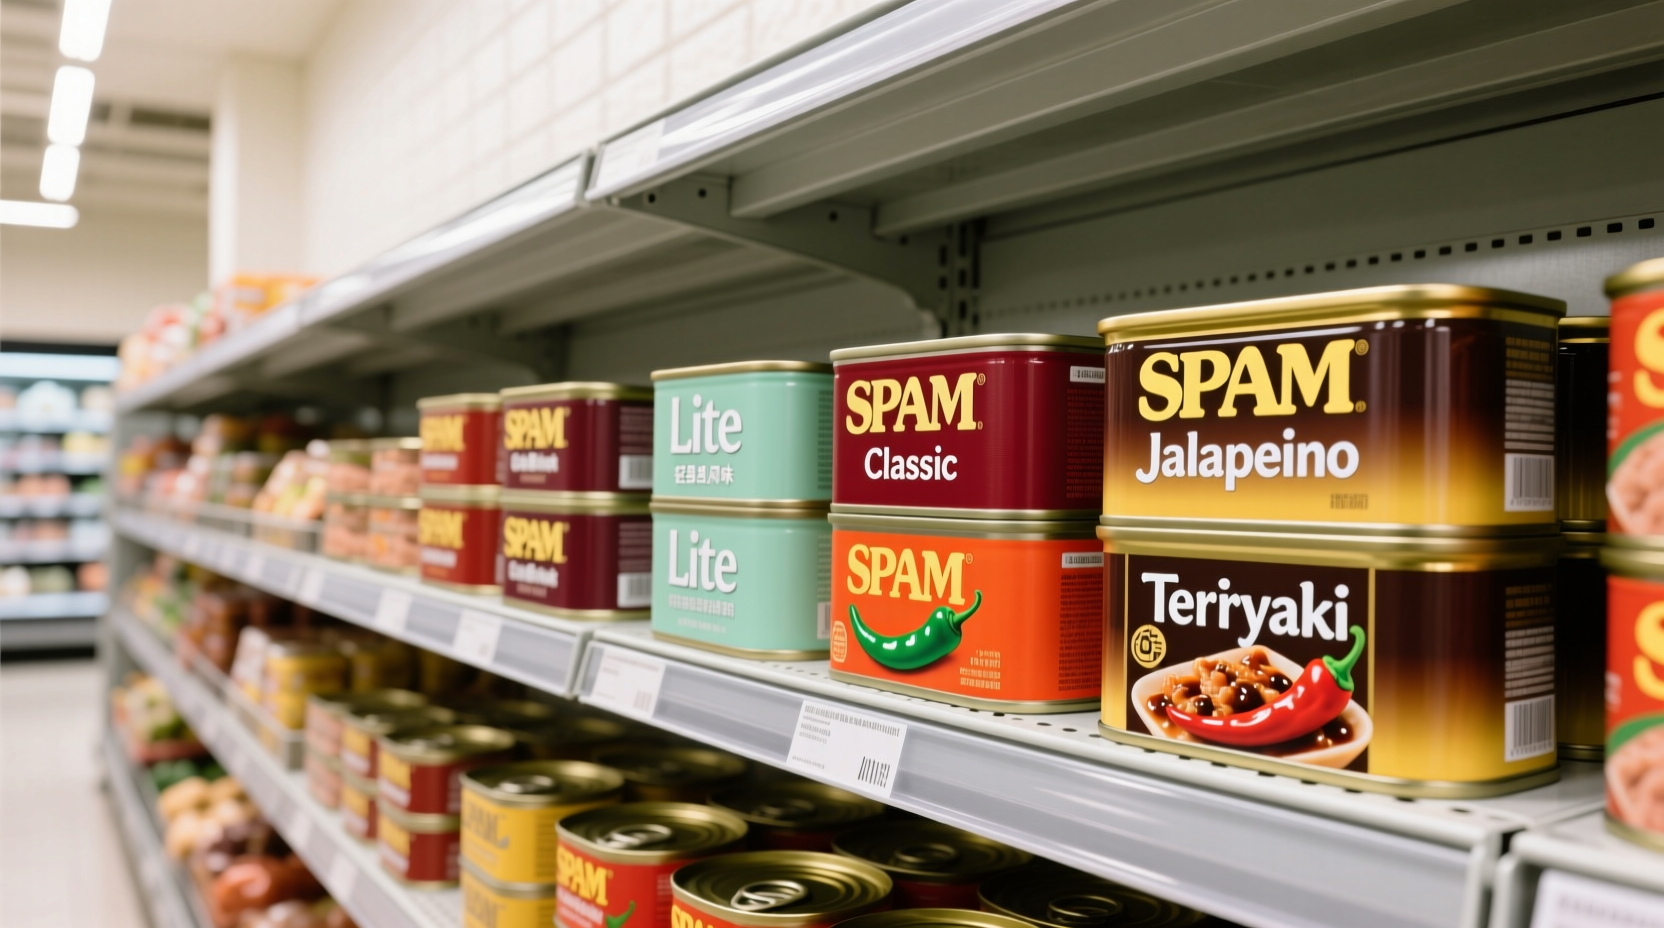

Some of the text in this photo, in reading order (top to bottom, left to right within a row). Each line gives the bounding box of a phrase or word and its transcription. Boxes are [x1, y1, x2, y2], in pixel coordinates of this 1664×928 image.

[846, 372, 977, 435] SPAM
[1138, 339, 1356, 421] SPAM
[503, 406, 566, 450] SPAM
[670, 393, 743, 455] Lite
[864, 445, 958, 480] Classic
[1135, 427, 1360, 492] Jalapeino
[503, 516, 564, 564] SPAM
[668, 529, 739, 593] Lite
[847, 543, 966, 606] SPAM
[556, 845, 608, 906] SPAM
